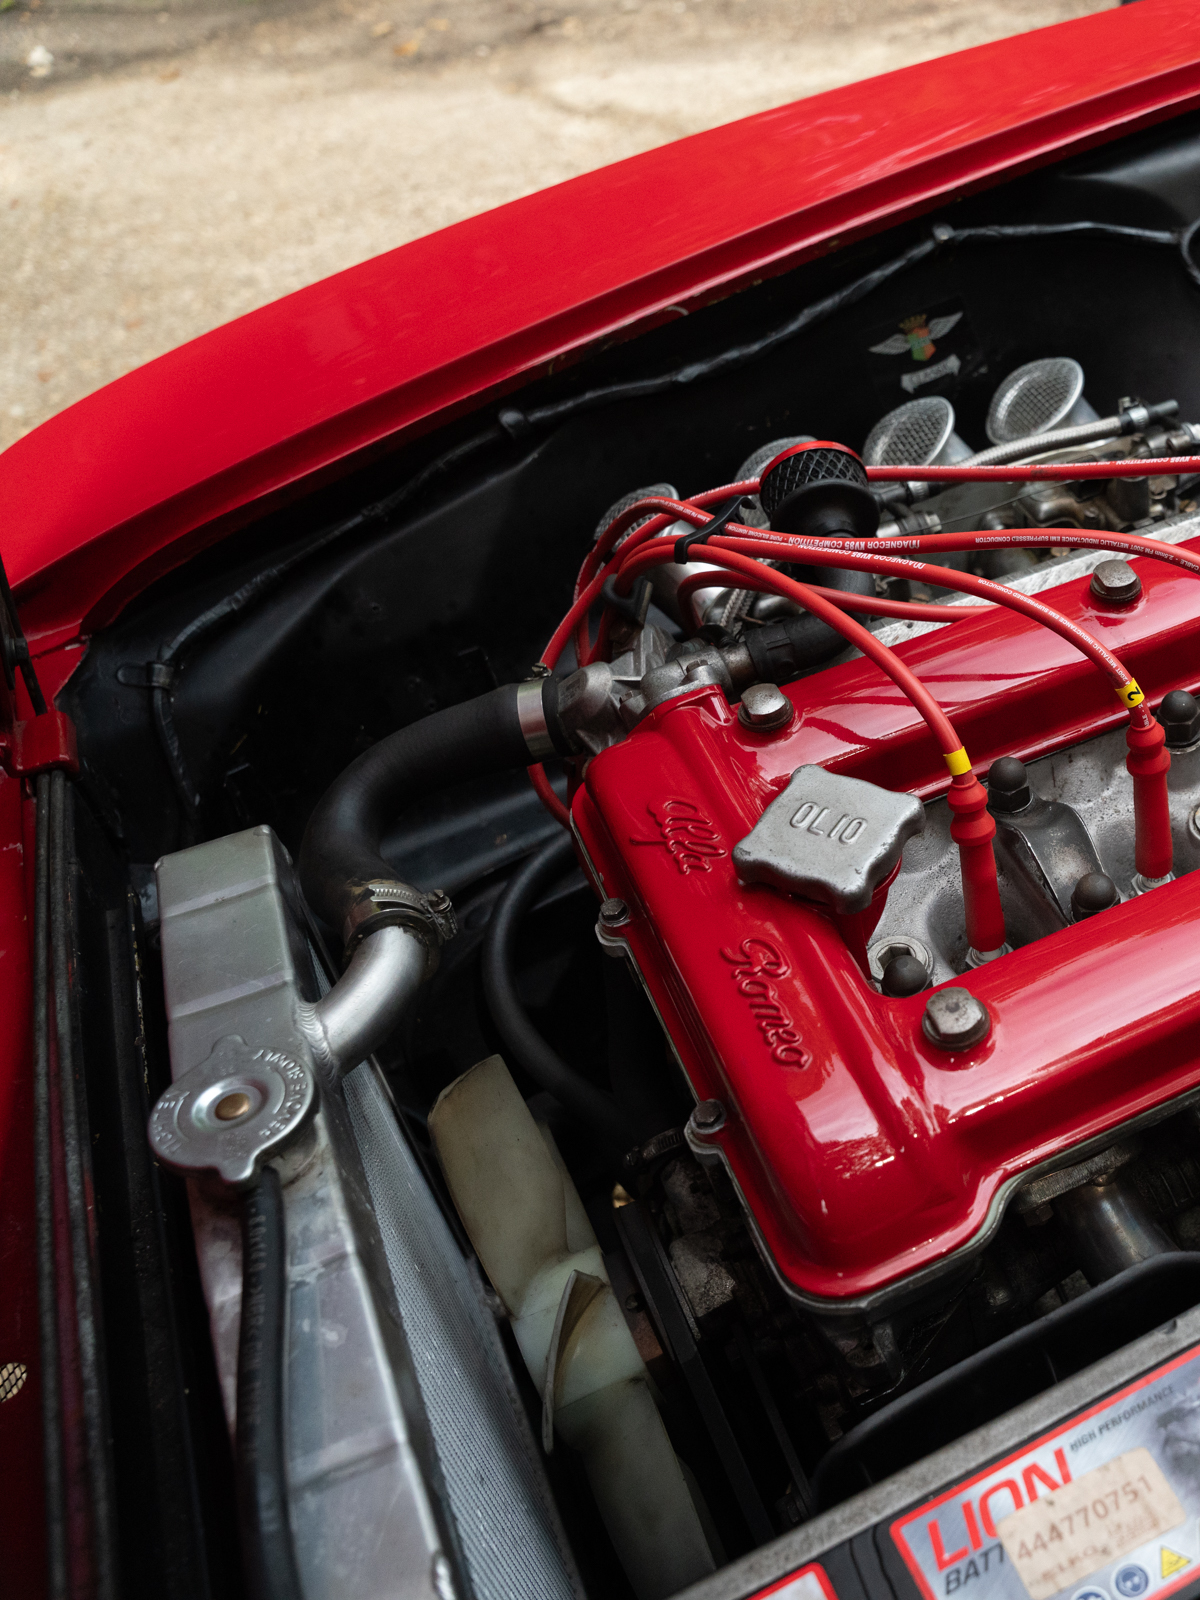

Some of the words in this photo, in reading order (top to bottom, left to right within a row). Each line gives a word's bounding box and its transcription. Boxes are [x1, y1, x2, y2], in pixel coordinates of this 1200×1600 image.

[788, 536, 843, 549] COMPETITION
[844, 540, 866, 551] KV85
[867, 539, 920, 550] MAGNECOR
[975, 536, 1011, 544] CONDUCTOR
[1061, 536, 1100, 545] INDUCTANCE
[1100, 539, 1129, 550] METALLIC
[850, 550, 873, 560] KV85
[1129, 544, 1145, 553] 200T
[1144, 547, 1154, 555] FM
[873, 553, 926, 570] MAGNECOR
[1154, 550, 1175, 561] 2.5mm
[1180, 559, 1200, 571] CABLE
[977, 578, 1013, 595] CONDUCTOR
[1012, 592, 1049, 613] SUPPRESSED
[1047, 609, 1059, 620] EMI
[1059, 617, 1094, 646] INDUCTANCE
[1092, 642, 1118, 668] METALLIC
[1126, 685, 1142, 702] 2
[789, 801, 869, 846] OLIO
[720, 938, 814, 1070] Romeo
[1069, 1429, 1097, 1452] HIGH
[1097, 1384, 1174, 1436] PERFORMANCE
[927, 1446, 1073, 1573] LION
[944, 1541, 1005, 1596] BATT
